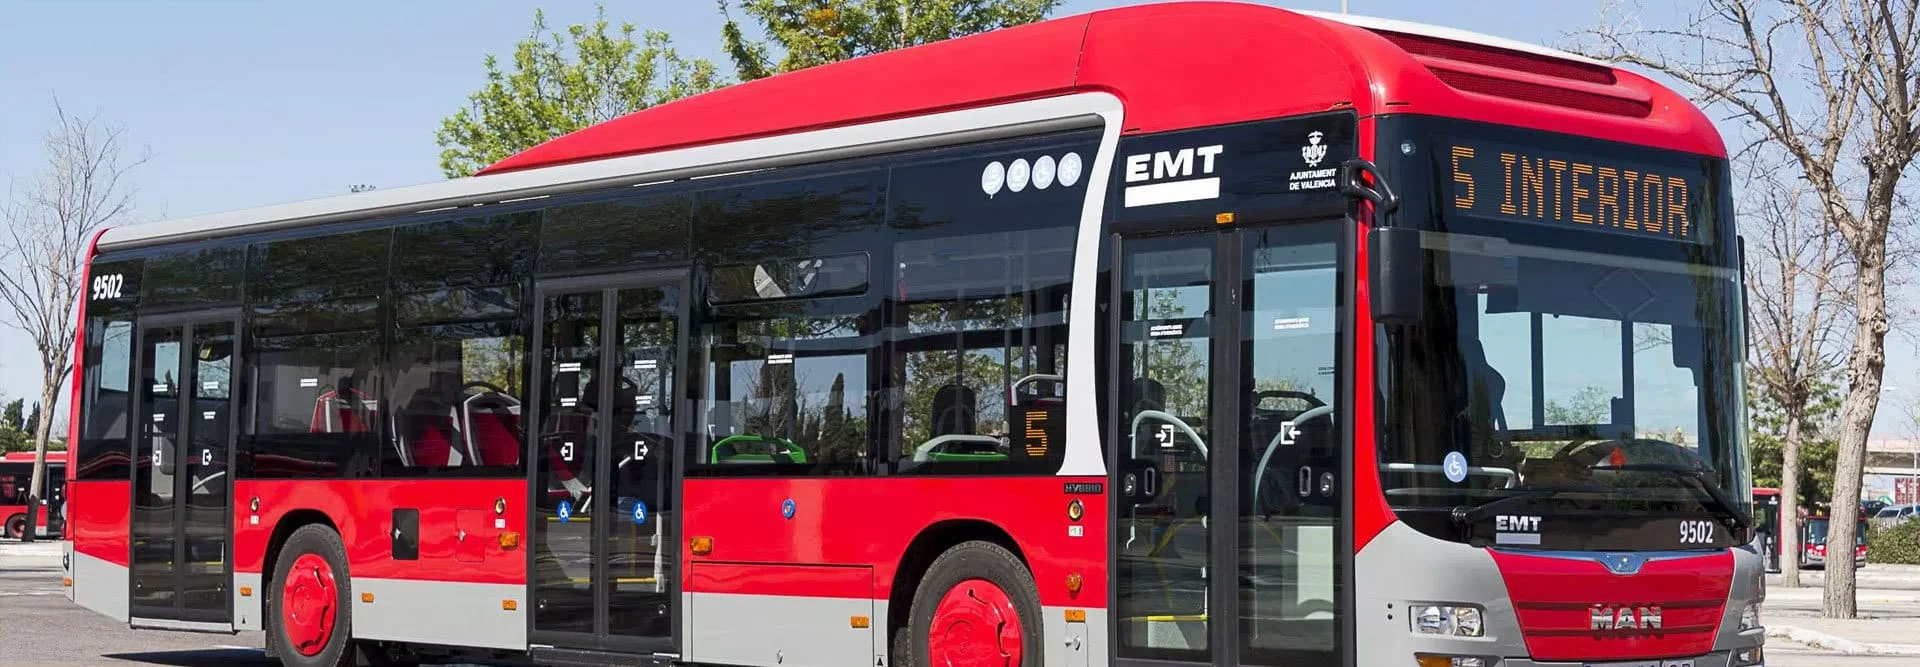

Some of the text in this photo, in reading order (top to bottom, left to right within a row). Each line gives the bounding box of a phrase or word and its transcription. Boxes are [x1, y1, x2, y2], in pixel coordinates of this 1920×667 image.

[1125, 144, 1223, 183] EMT
[1289, 168, 1337, 181] AJUNTAMENT
[1289, 178, 1336, 191] DE VALENCIA
[1452, 145, 1688, 237] 5 INTERIOR
[93, 273, 123, 301] 9502
[1026, 411, 1048, 456] 5
[1064, 483, 1102, 493] HYBRID
[1495, 515, 1542, 532] EMT
[1680, 520, 1714, 544] 9502
[1590, 606, 1662, 631] MAN
